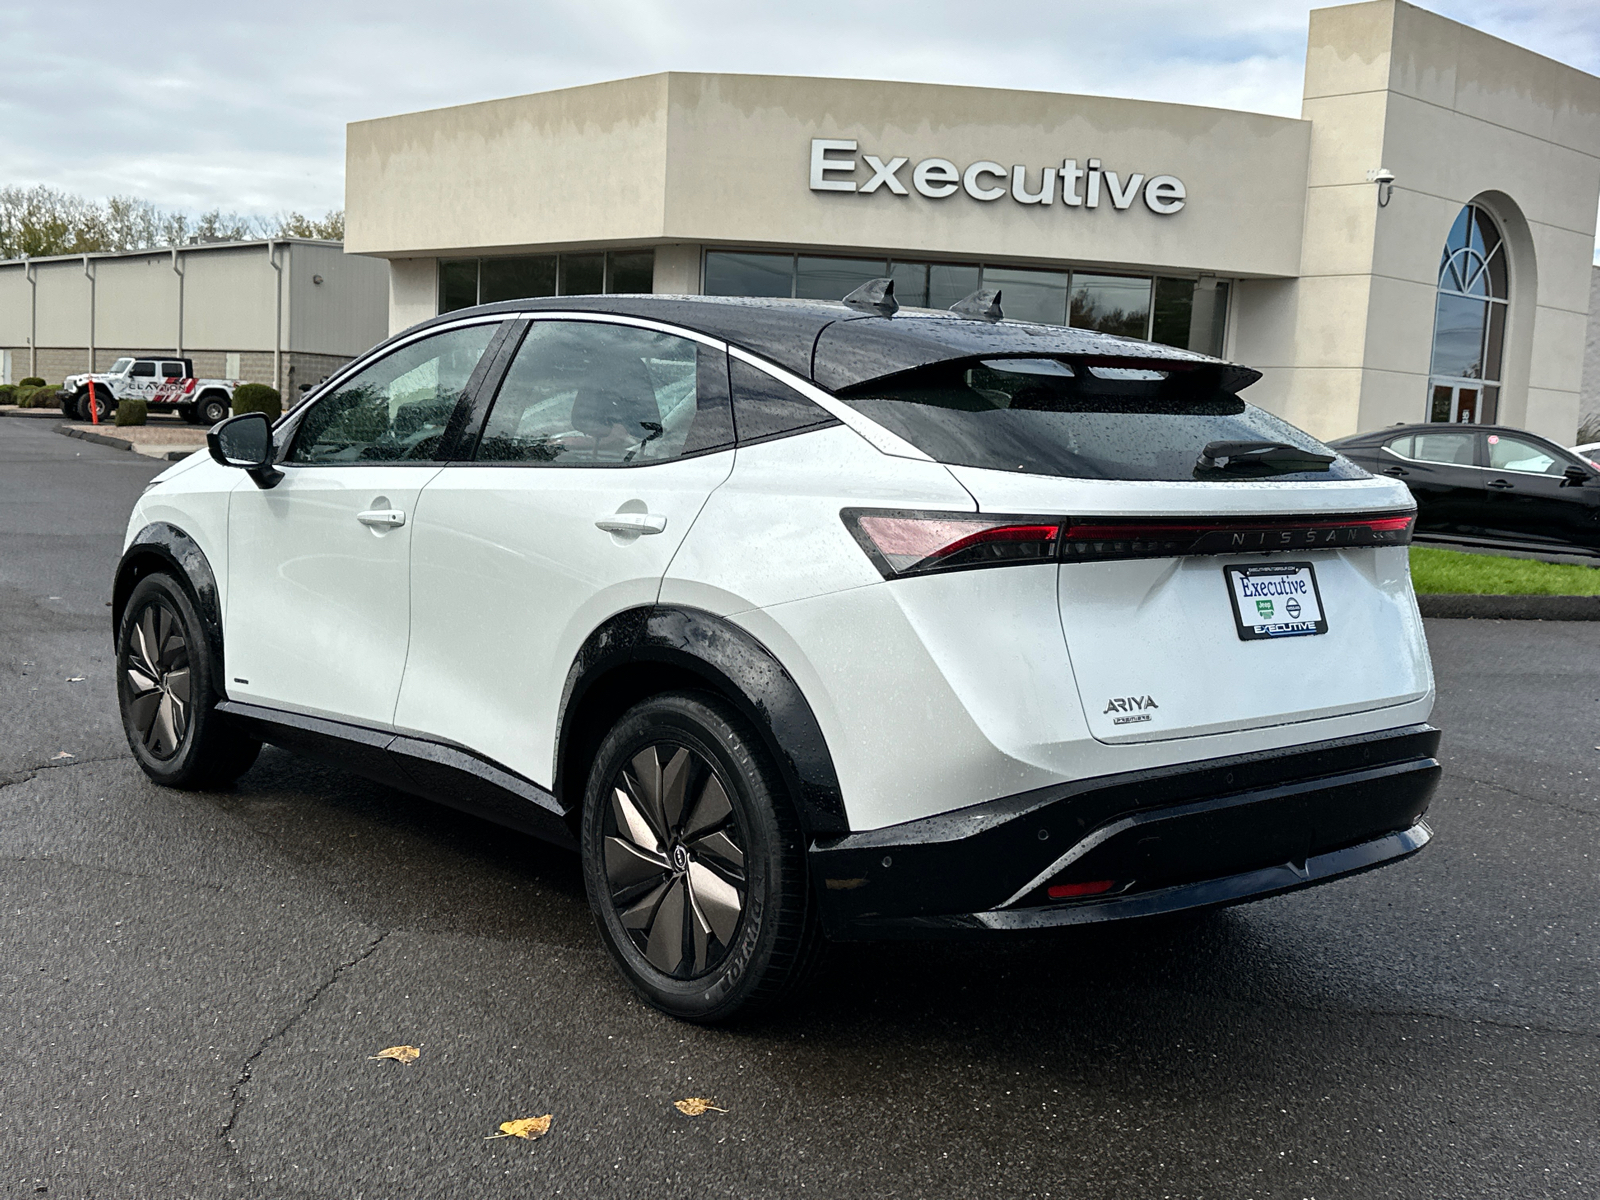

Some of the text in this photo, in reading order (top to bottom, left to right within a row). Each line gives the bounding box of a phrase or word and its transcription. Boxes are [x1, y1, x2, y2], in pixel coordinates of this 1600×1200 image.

[809, 137, 1187, 215] Executive
[128, 382, 186, 392] CLAYTON
[1231, 527, 1358, 547] NISSAN
[1239, 576, 1307, 597] Executive
[1253, 621, 1317, 634] EXECUTIVE
[1103, 694, 1159, 714] ARIYA
